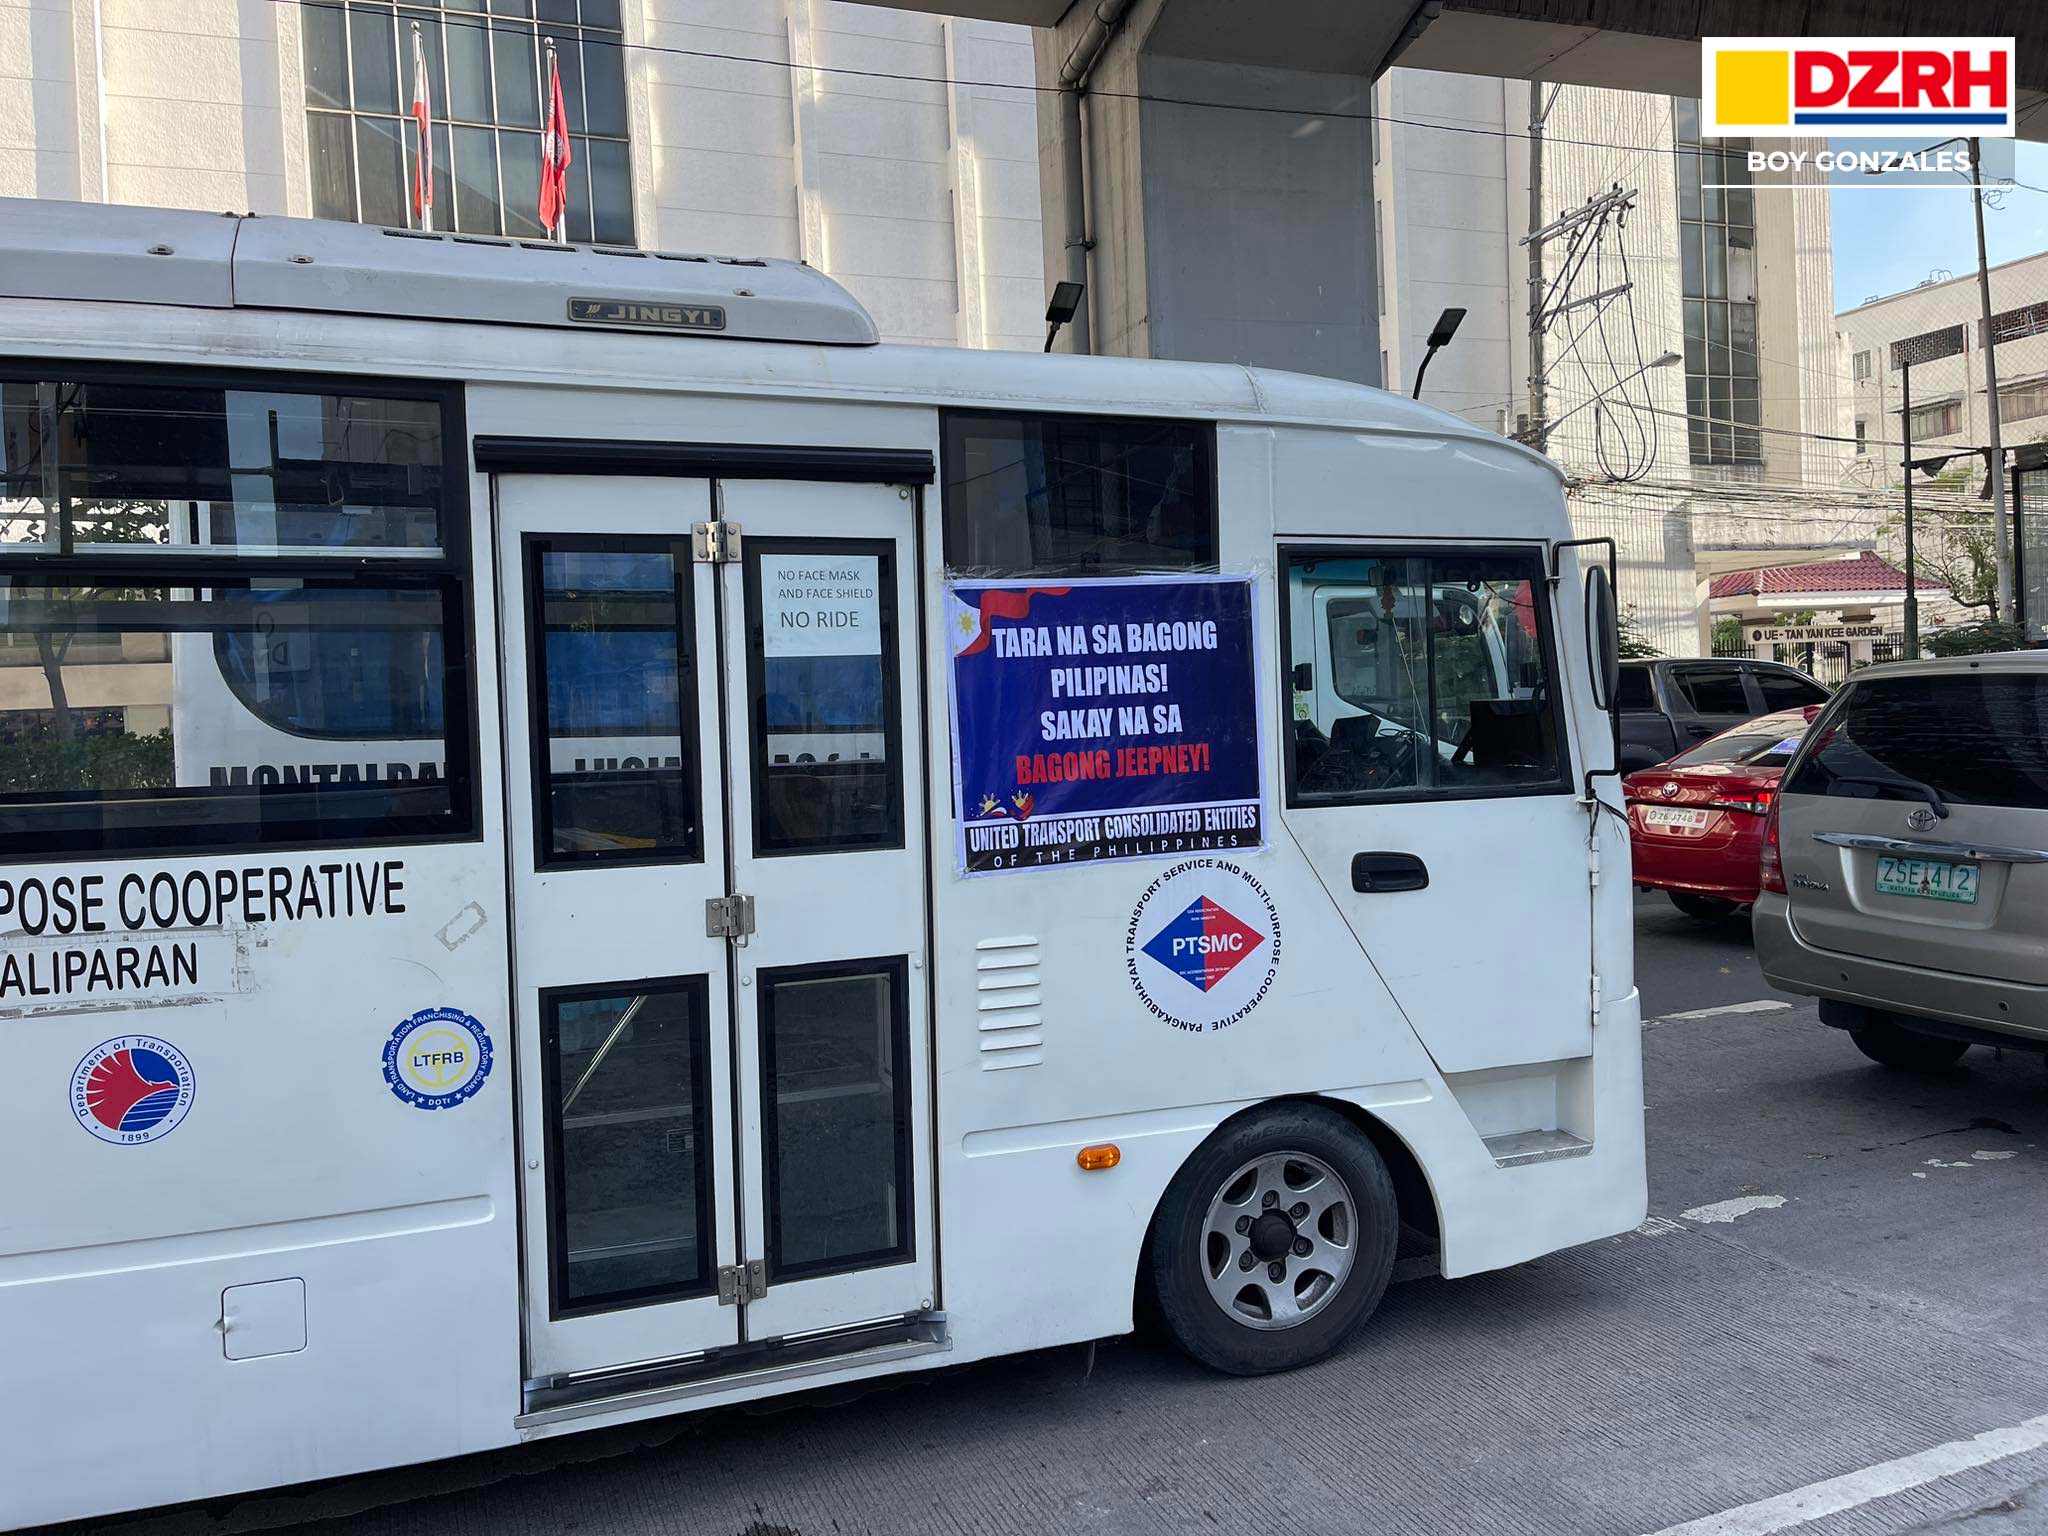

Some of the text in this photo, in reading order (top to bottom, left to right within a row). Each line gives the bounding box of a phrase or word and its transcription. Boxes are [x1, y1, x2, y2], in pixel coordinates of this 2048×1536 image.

[607, 304, 711, 325] JINGYI
[778, 570, 860, 580] NO FACE MASK
[779, 588, 873, 599] AND FACE SHIELD
[781, 611, 860, 628] NO RIDE
[1764, 630, 1778, 640] UE
[1784, 629, 1803, 640] TAN
[1805, 628, 1823, 639] YAN
[1825, 627, 1844, 638] KEE
[1845, 626, 1883, 637] GARDEN
[991, 620, 1218, 658] TARA NA SA BAGONG
[1050, 663, 1169, 698] PILIPINAS!
[1040, 704, 1183, 741] SAKAY NA SA
[1015, 743, 1210, 785] BAGONG JEEPNEY!
[970, 805, 1257, 853] UNITED TRANSPORT CONSOLIDATED ENTITIES
[993, 836, 1238, 868] OF THE PHILIPPINES
[1216, 860, 1241, 875] AND
[1163, 859, 1213, 882] SERVICE
[1883, 860, 1970, 890] ZSE 412
[118, 860, 407, 931] COOPERATIVE
[1126, 879, 1161, 953] TRANSPORT
[1242, 871, 1282, 965] MULTI-PURPOSE
[1173, 932, 1243, 957] PTSMC
[1126, 957, 1203, 1033] PANGKABUHAYAN
[1211, 968, 1276, 1031] COOPERATIVE
[412, 1012, 465, 1026] FRANCHISING
[388, 1023, 413, 1085] TRANSPORTATION
[414, 1051, 464, 1067] LTFRB
[470, 1025, 489, 1070] REGULATORY
[76, 1038, 192, 1117] Department of Transportation
[397, 1083, 415, 1099] LAND
[464, 1070, 484, 1093] BOARD
[120, 1131, 150, 1142] 1899
